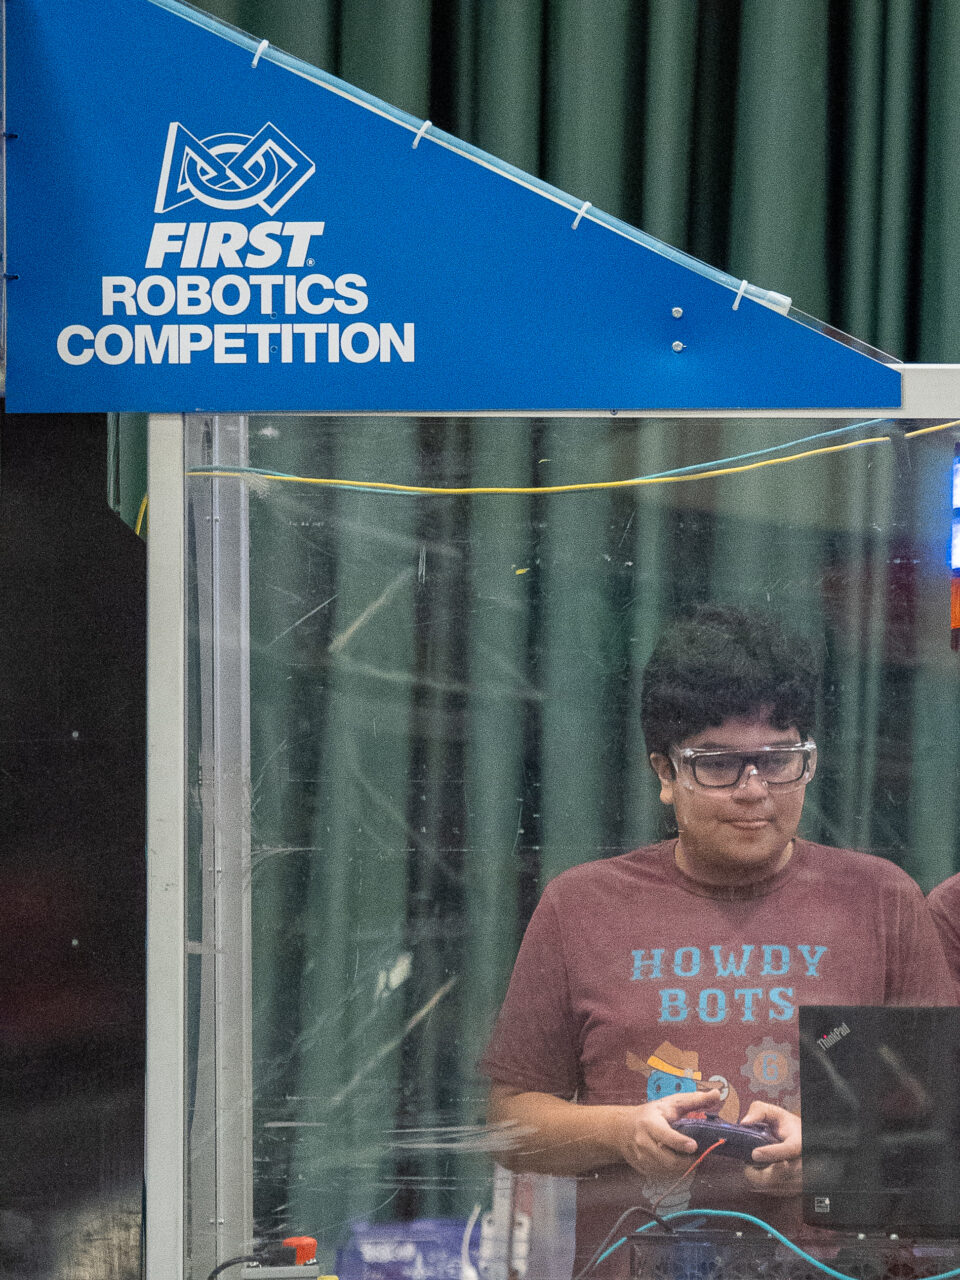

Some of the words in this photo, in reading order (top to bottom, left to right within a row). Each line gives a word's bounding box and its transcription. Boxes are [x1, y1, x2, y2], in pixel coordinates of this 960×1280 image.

[145, 221, 325, 268] FIRST
[101, 273, 369, 316] ROBOTICS
[56, 322, 415, 366] COMPETITION
[630, 945, 828, 981] HOWDY
[657, 986, 796, 1023] BOTS
[816, 1022, 851, 1051] ThinkPad
